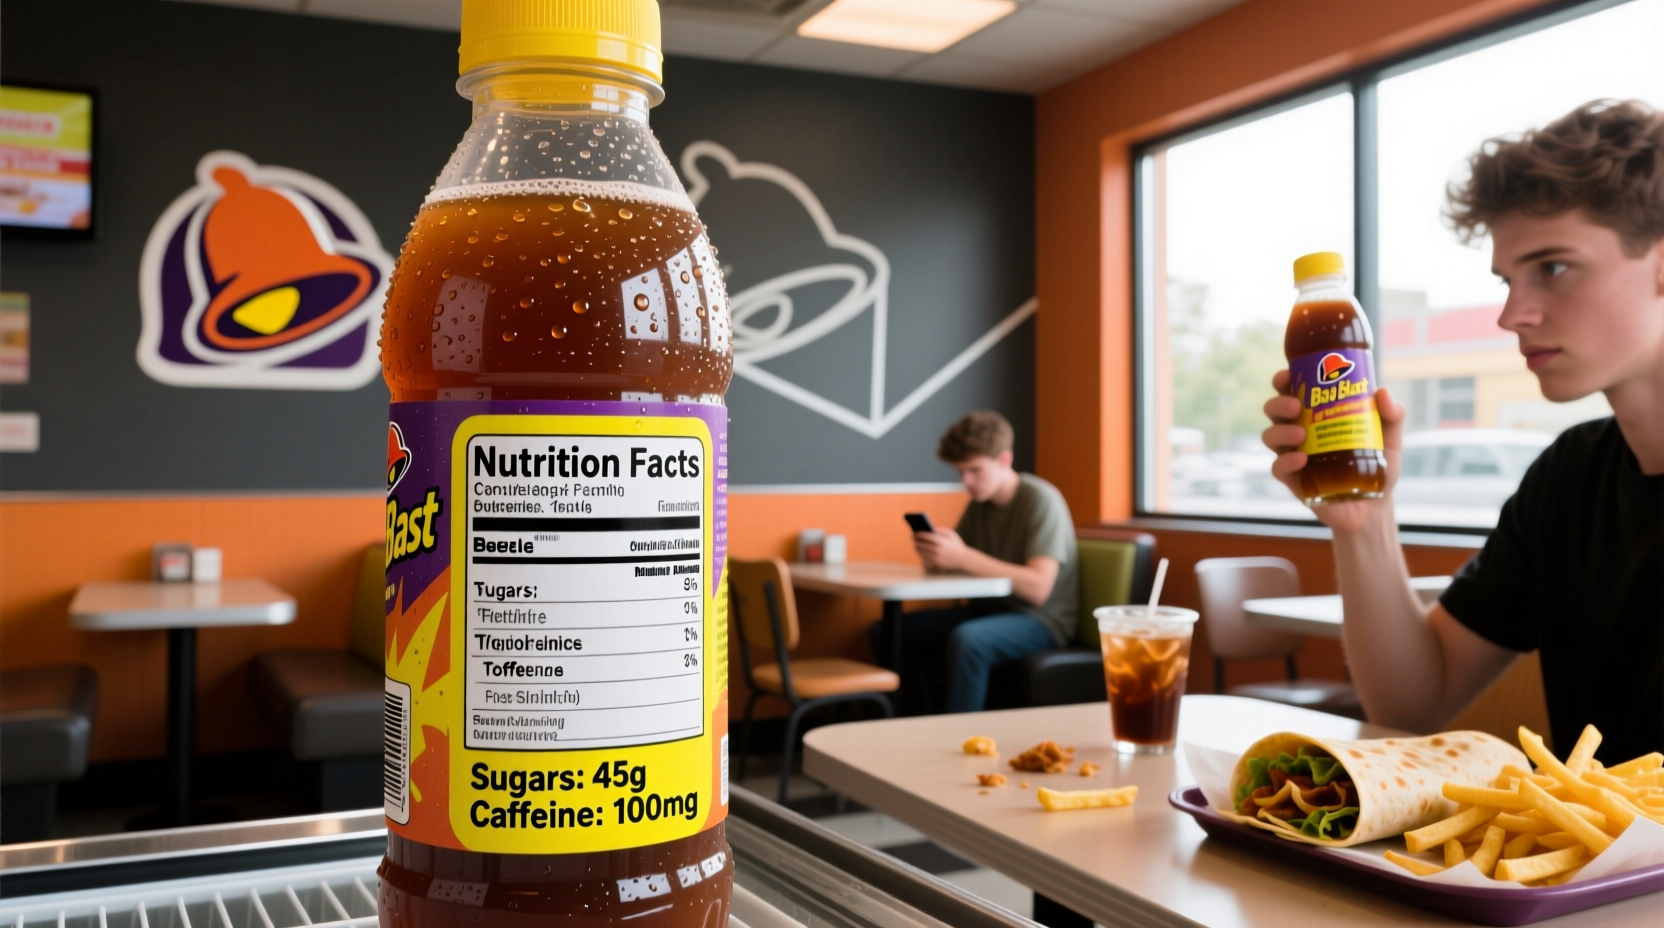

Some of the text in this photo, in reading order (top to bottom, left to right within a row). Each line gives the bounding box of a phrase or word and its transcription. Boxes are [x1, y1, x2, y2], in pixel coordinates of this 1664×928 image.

[474, 445, 700, 478] Nutrition Facts
[470, 761, 646, 798] Sugars: 45g
[470, 791, 698, 829] Caffeine: 100mg
